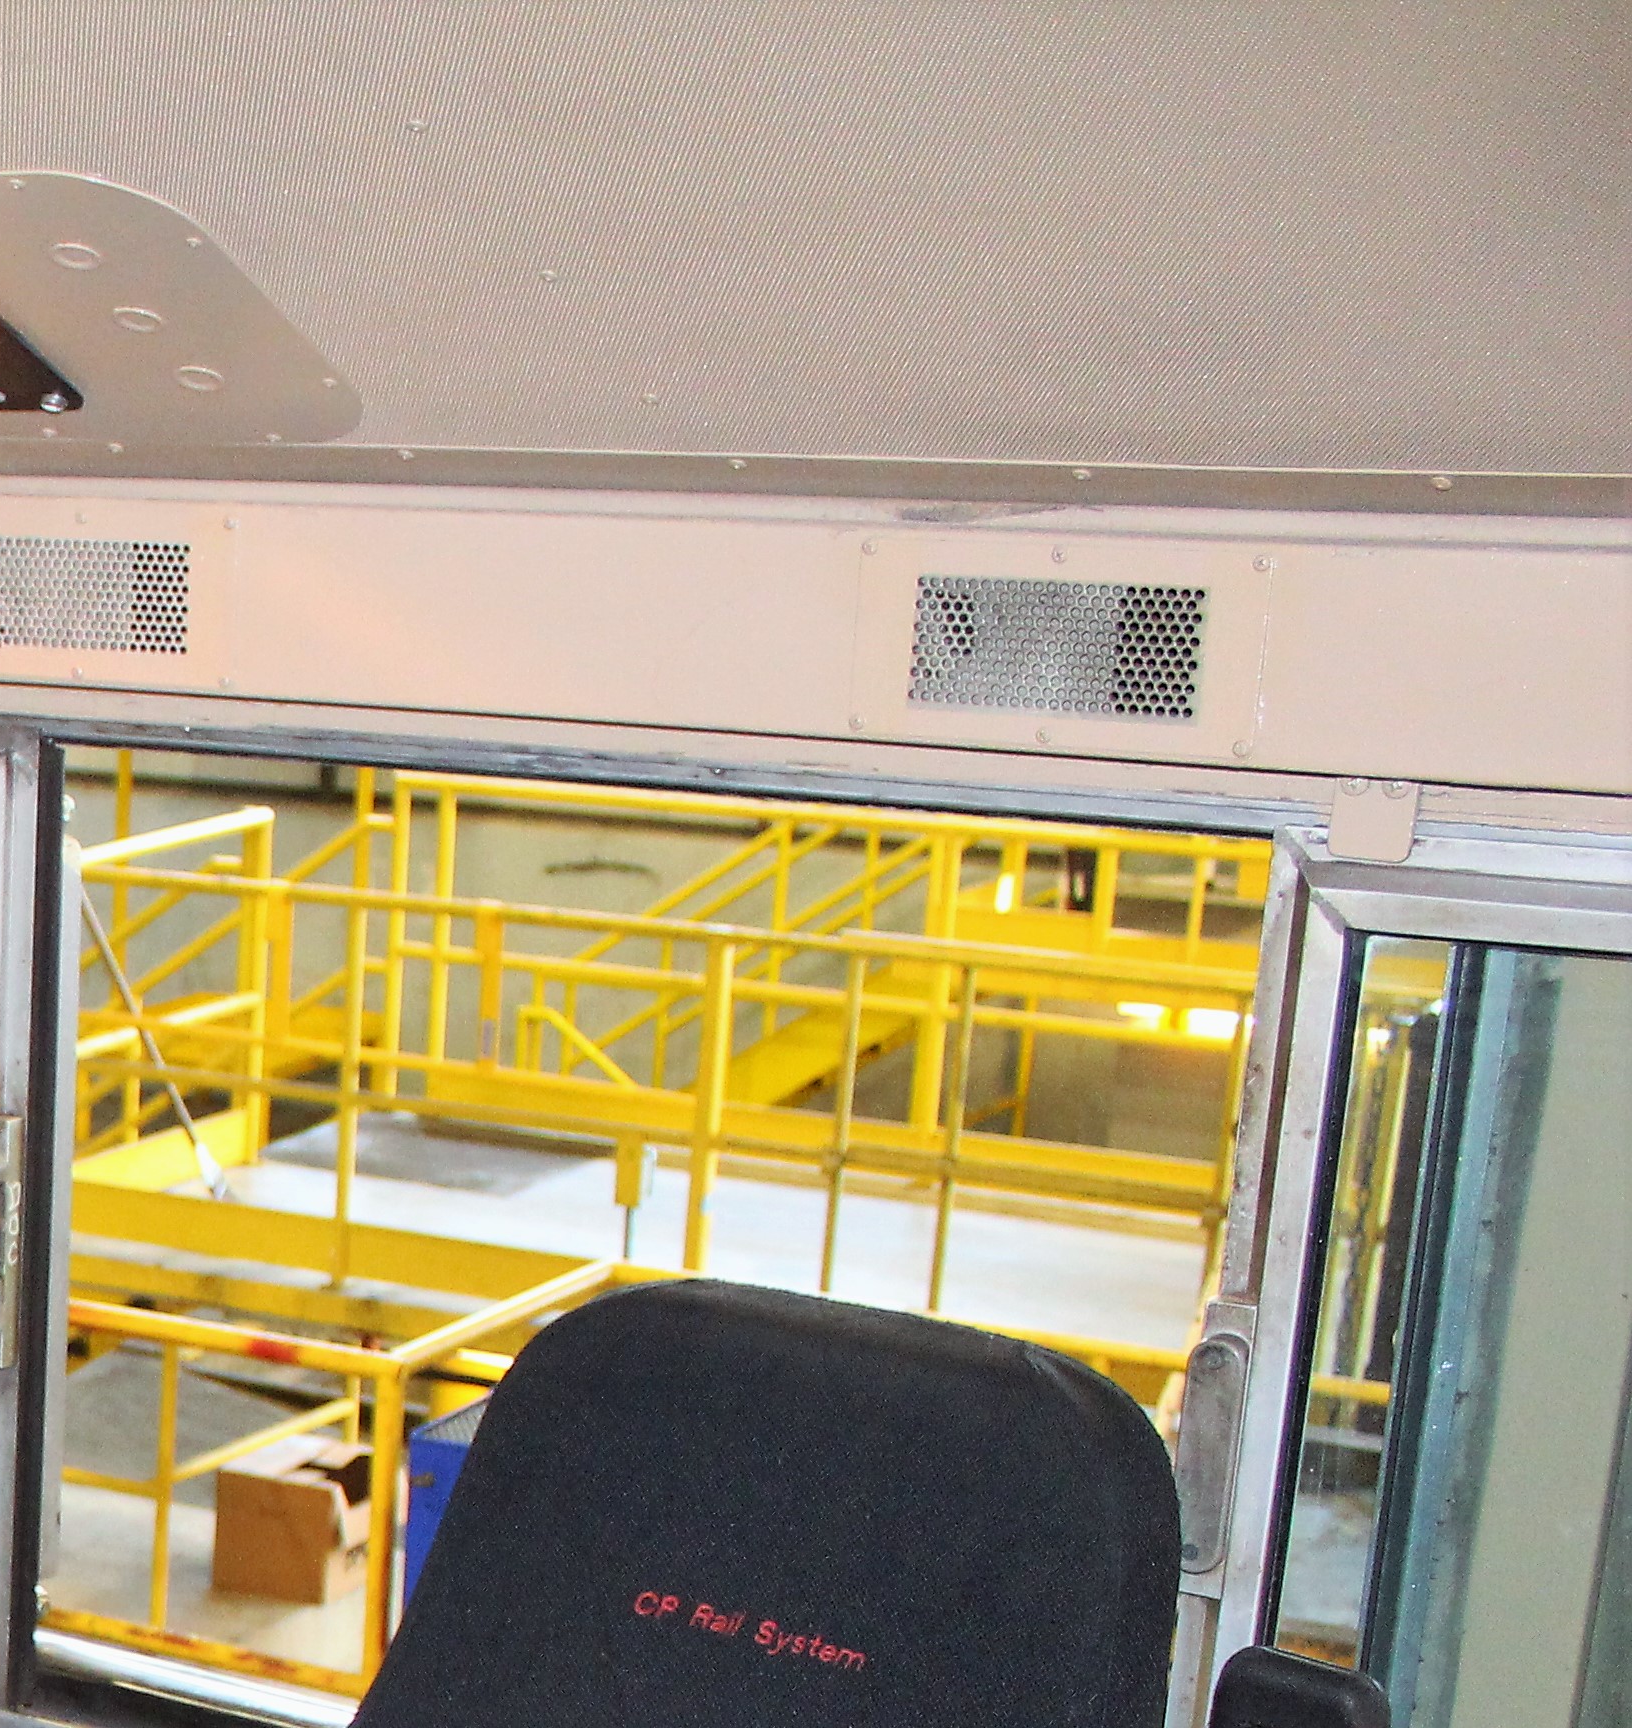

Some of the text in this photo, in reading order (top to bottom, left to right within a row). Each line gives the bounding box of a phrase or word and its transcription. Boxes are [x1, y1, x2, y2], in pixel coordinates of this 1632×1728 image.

[633, 1590, 869, 1672] CP Rail System
